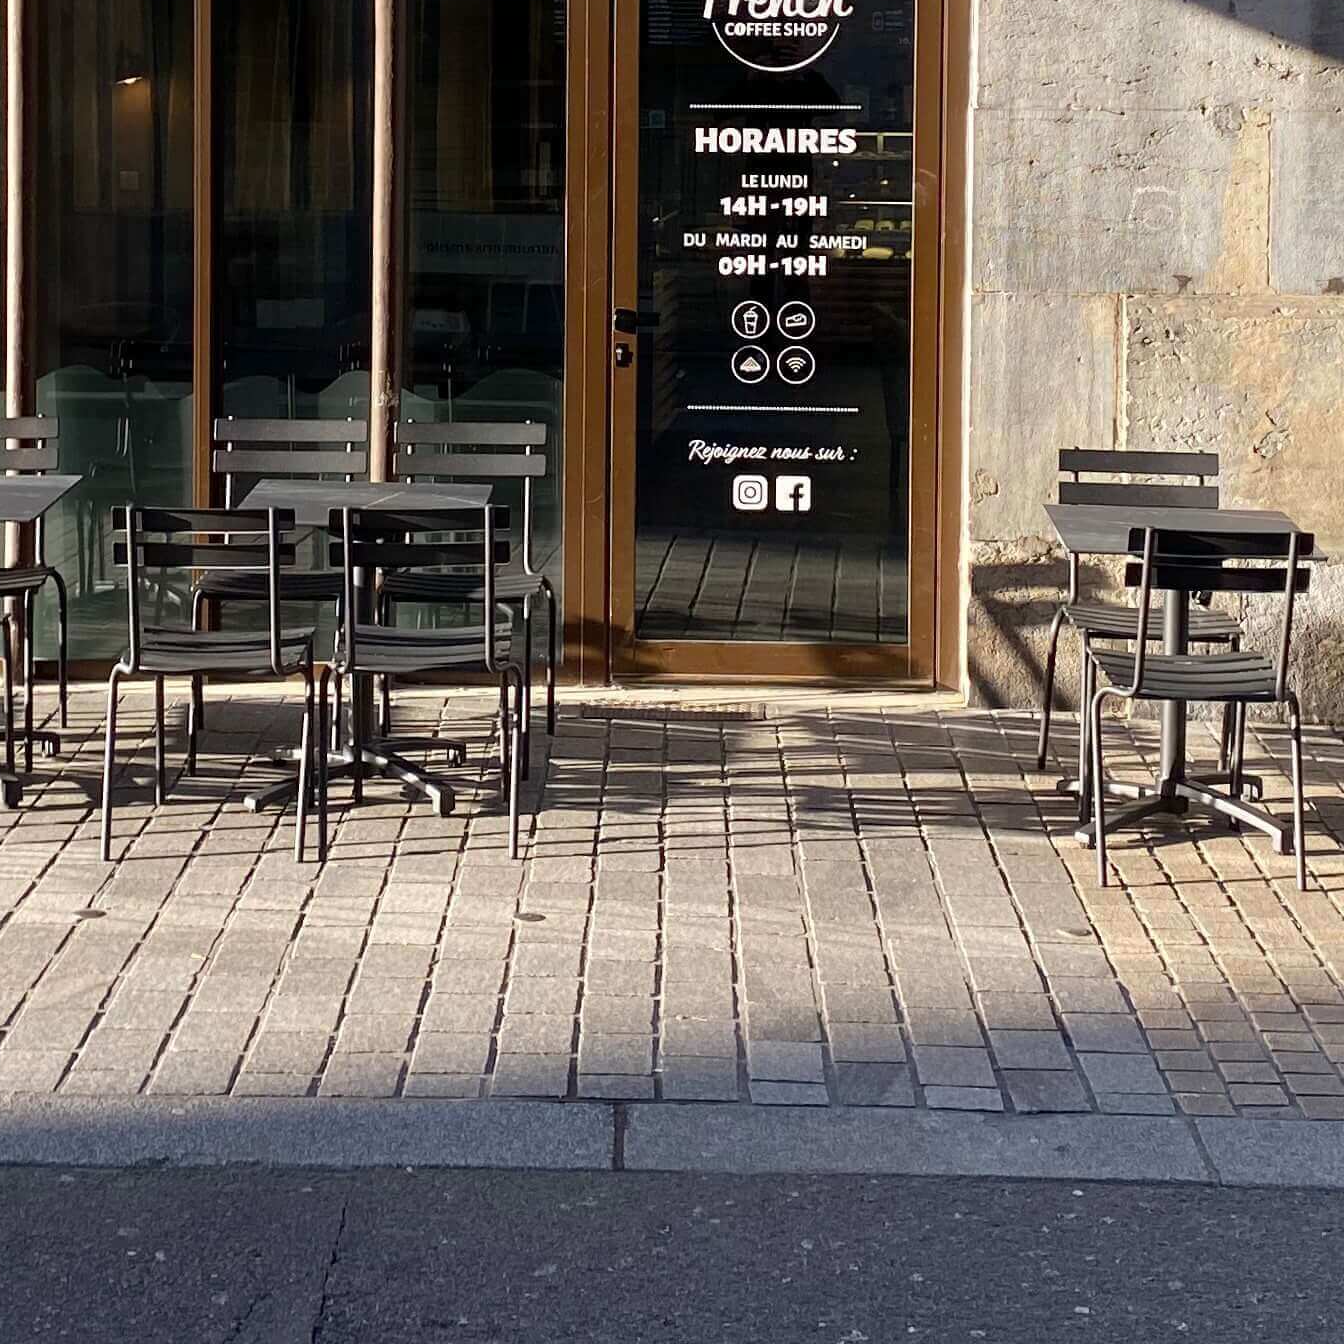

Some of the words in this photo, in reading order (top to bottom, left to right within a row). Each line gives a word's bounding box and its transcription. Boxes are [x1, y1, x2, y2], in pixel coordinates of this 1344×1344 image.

[724, 22, 782, 37] COFFEE
[783, 22, 828, 37] SHOP
[695, 127, 858, 154] HORAIRES
[741, 174, 759, 188] LE
[760, 174, 808, 189] LUNDI
[683, 232, 706, 247] DU
[715, 232, 767, 248] MARDI
[775, 234, 799, 249] AU
[809, 235, 867, 250] SAMEDI
[688, 439, 768, 465] Rejoignez
[769, 446, 813, 460] nous
